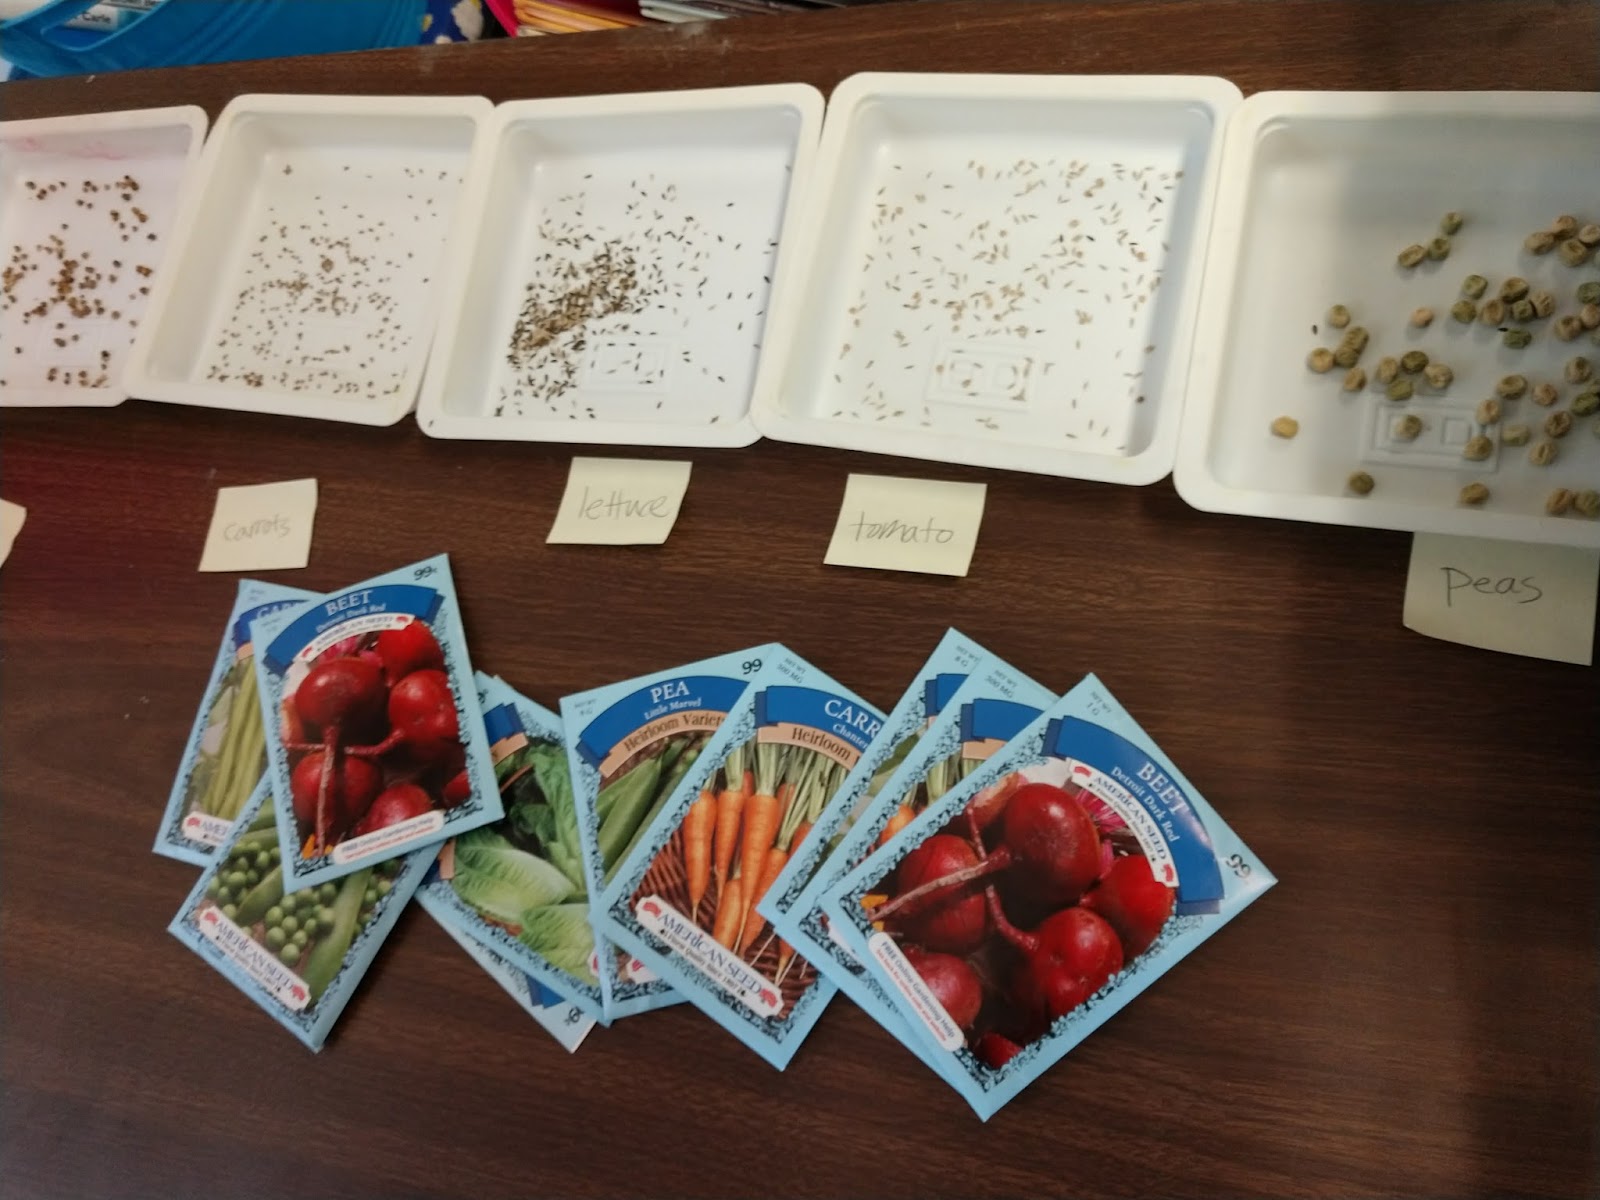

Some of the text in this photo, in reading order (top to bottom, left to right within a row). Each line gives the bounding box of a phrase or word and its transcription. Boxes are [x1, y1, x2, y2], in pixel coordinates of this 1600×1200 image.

[577, 486, 669, 520] lettuce
[223, 513, 291, 543] carrots
[849, 511, 955, 546] tomato
[325, 590, 374, 616] BEET
[651, 680, 690, 704] PEA
[669, 696, 702, 711] Marvel
[624, 712, 726, 751] Heirloom Variet
[792, 727, 851, 761] Heirloom
[1111, 766, 1181, 842] Detroit Dark Red
[1136, 760, 1190, 815] BEET
[1093, 776, 1167, 860] AMERICAN SEED
[657, 913, 762, 994] AMERICAN SEED
